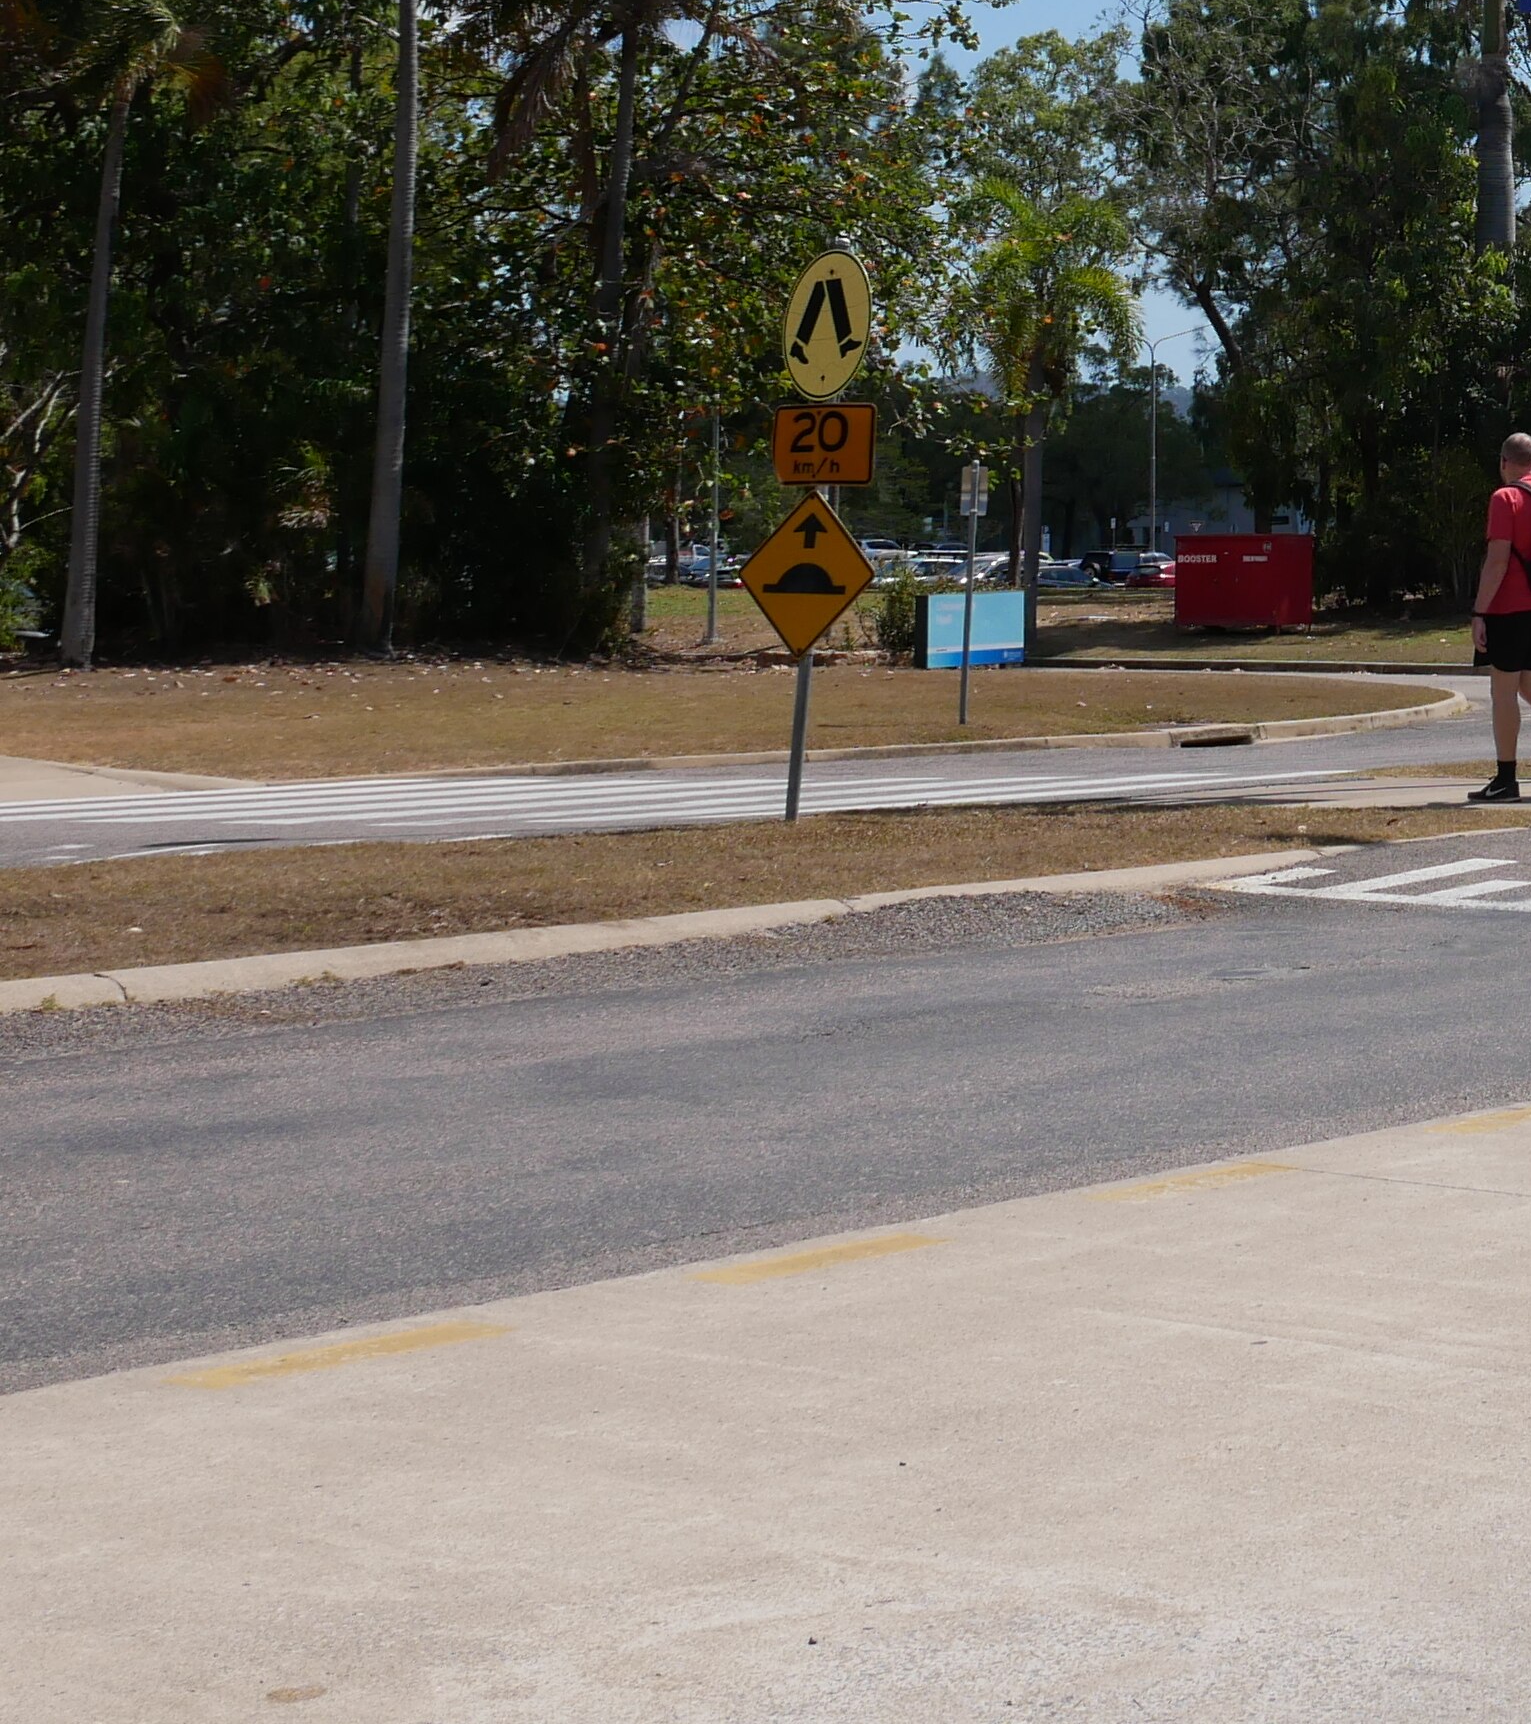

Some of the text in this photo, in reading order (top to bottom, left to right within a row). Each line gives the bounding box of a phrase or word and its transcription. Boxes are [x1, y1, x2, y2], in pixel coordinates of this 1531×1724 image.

[790, 410, 849, 453] 20
[793, 457, 840, 475] km/h
[1177, 555, 1217, 563] BOOSTER
